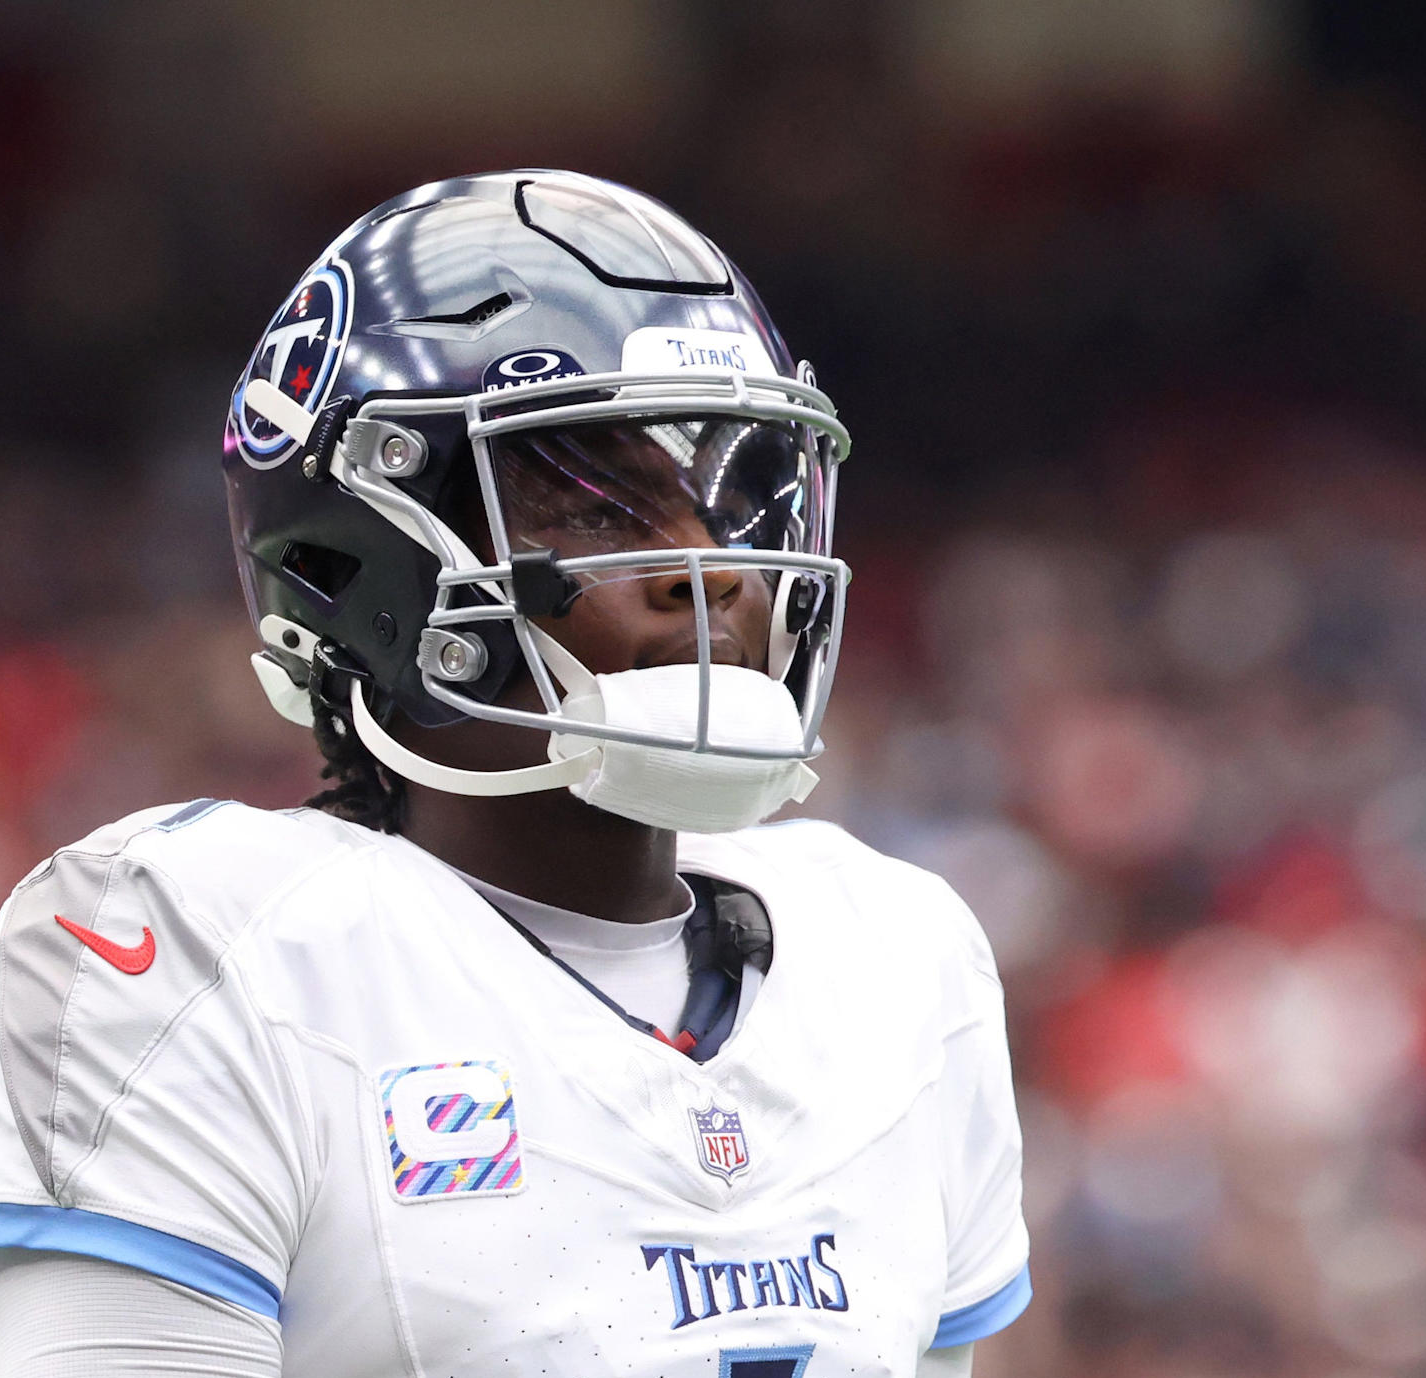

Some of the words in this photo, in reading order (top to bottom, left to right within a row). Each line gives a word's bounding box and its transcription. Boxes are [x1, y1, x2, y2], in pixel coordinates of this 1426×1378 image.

[666, 339, 746, 371] TITANS
[389, 1068, 513, 1163] C
[705, 1135, 745, 1168] NFL
[640, 1233, 849, 1330] TITANS
